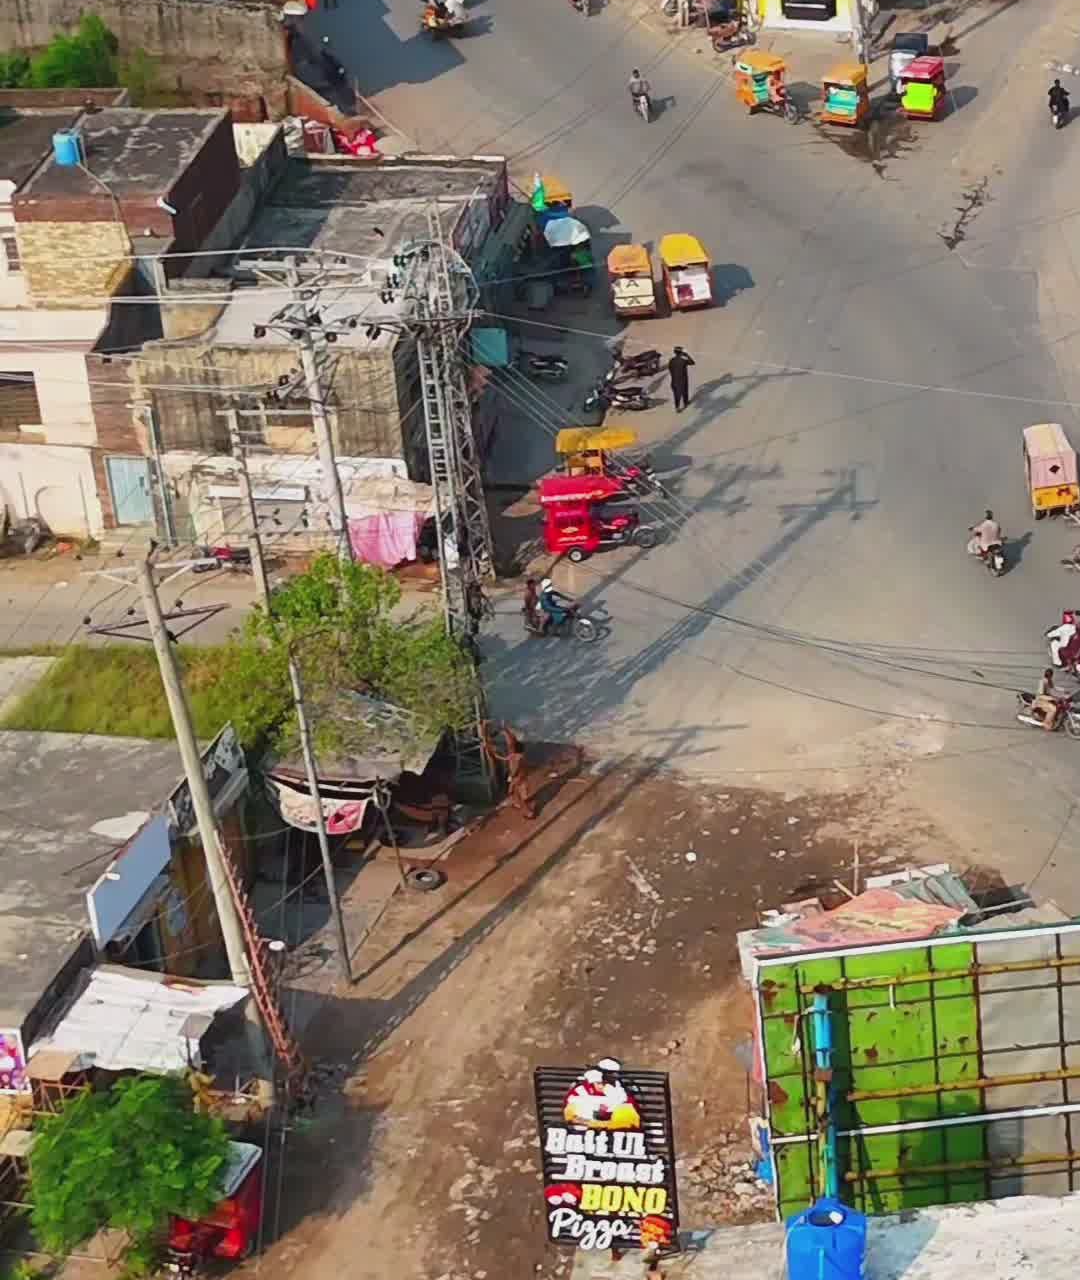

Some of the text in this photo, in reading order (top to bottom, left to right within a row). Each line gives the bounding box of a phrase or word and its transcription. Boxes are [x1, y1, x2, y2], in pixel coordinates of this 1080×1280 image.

[562, 1154, 665, 1184] Broast
[579, 1184, 667, 1214] BONO
[549, 1207, 633, 1250] Pizza
